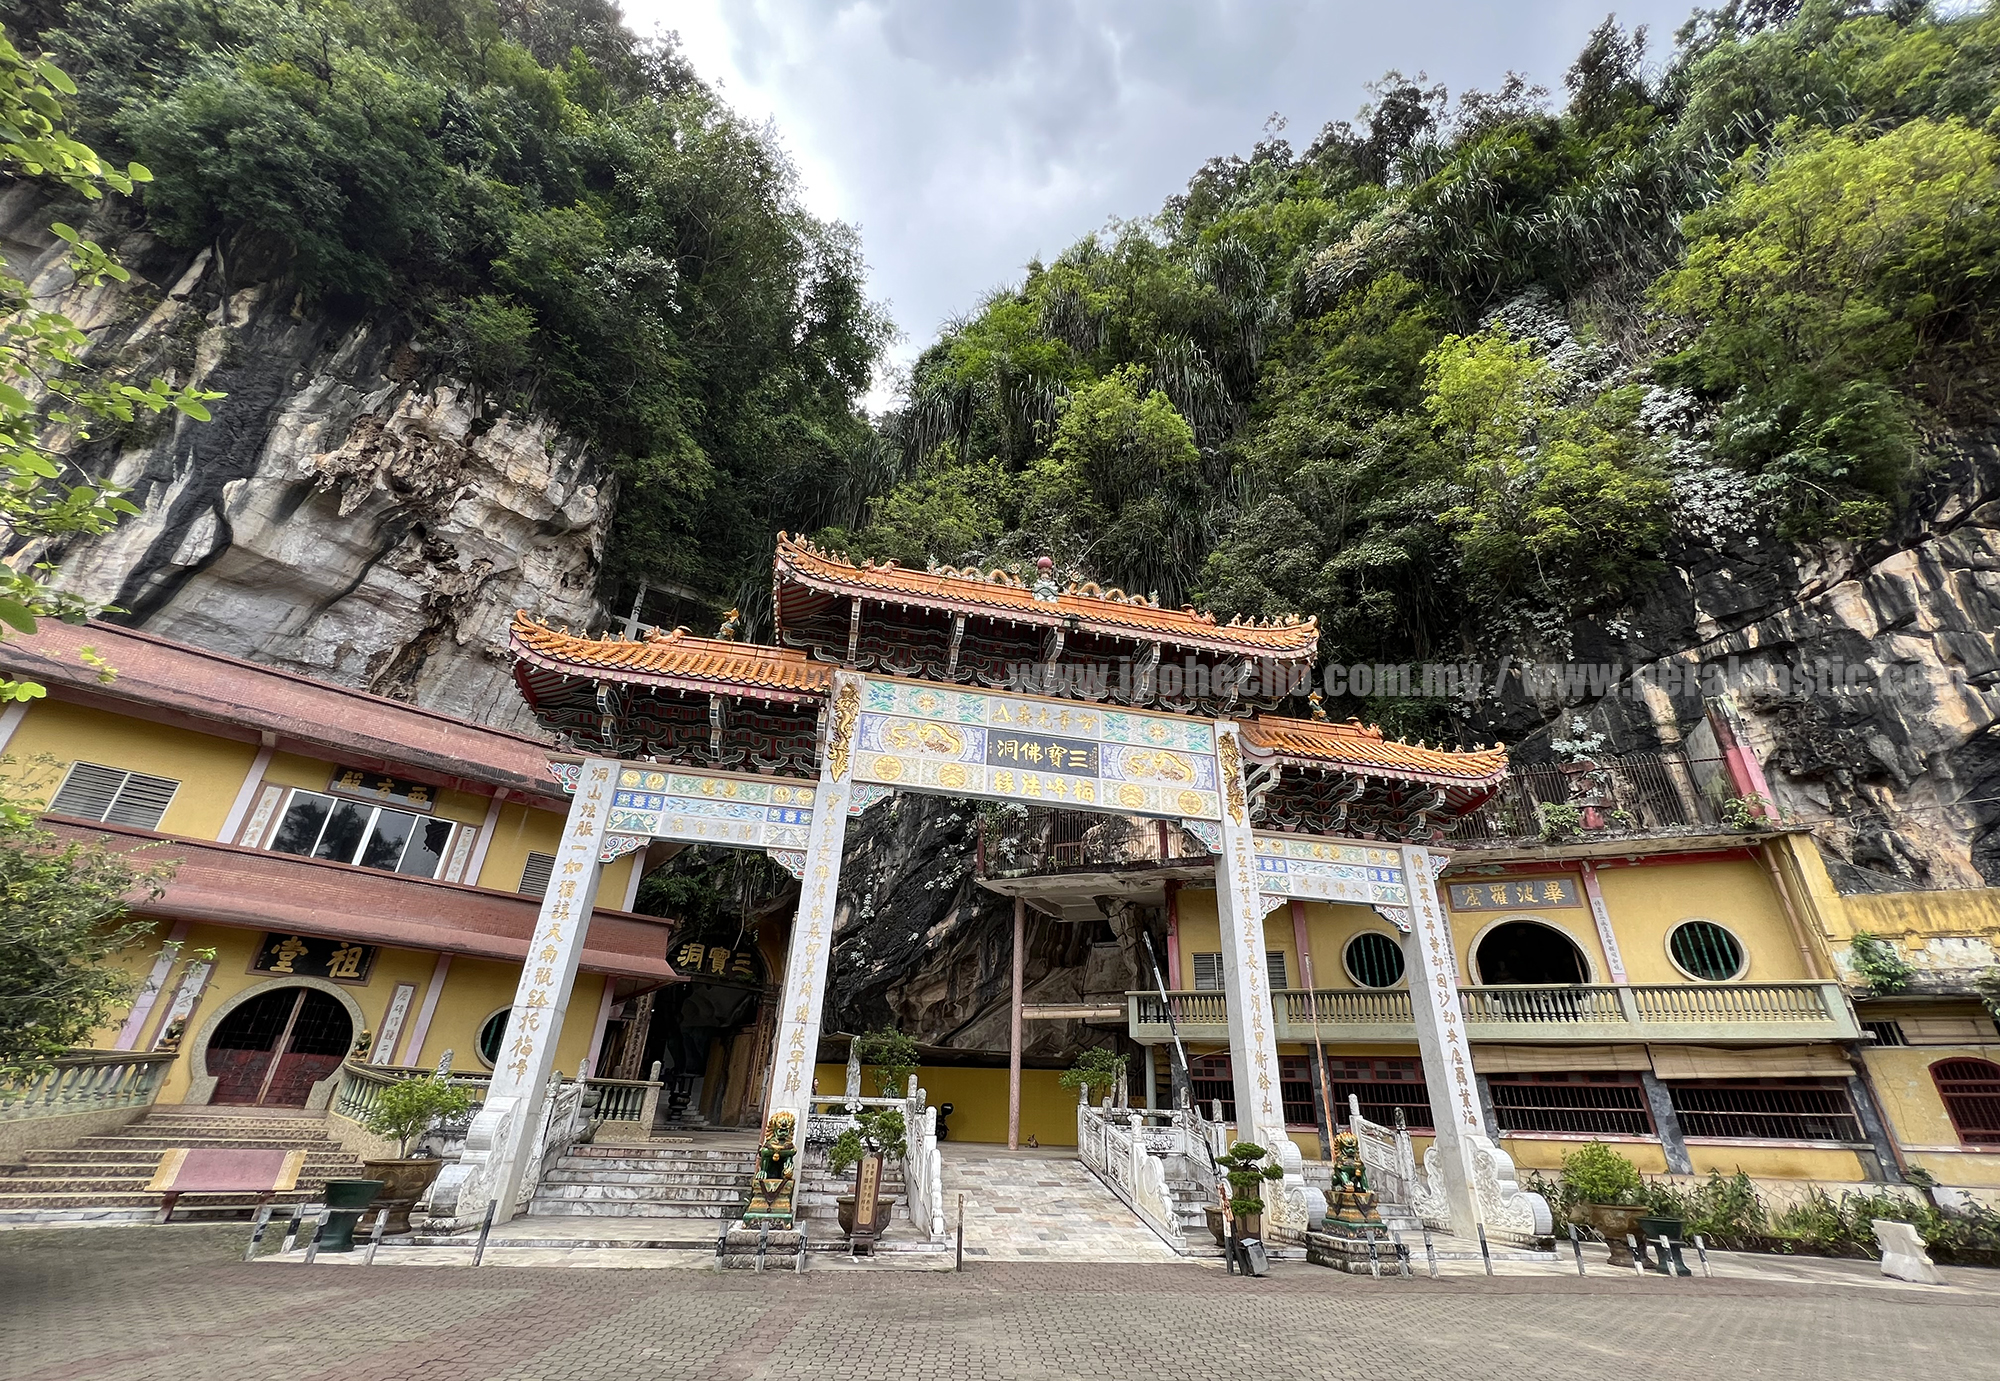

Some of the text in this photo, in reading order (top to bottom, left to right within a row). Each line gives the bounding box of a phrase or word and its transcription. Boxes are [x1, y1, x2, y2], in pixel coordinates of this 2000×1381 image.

[337, 770, 429, 806] 西方殿
[269, 936, 363, 979] 祖堂
[677, 943, 753, 977] 三寶洞
